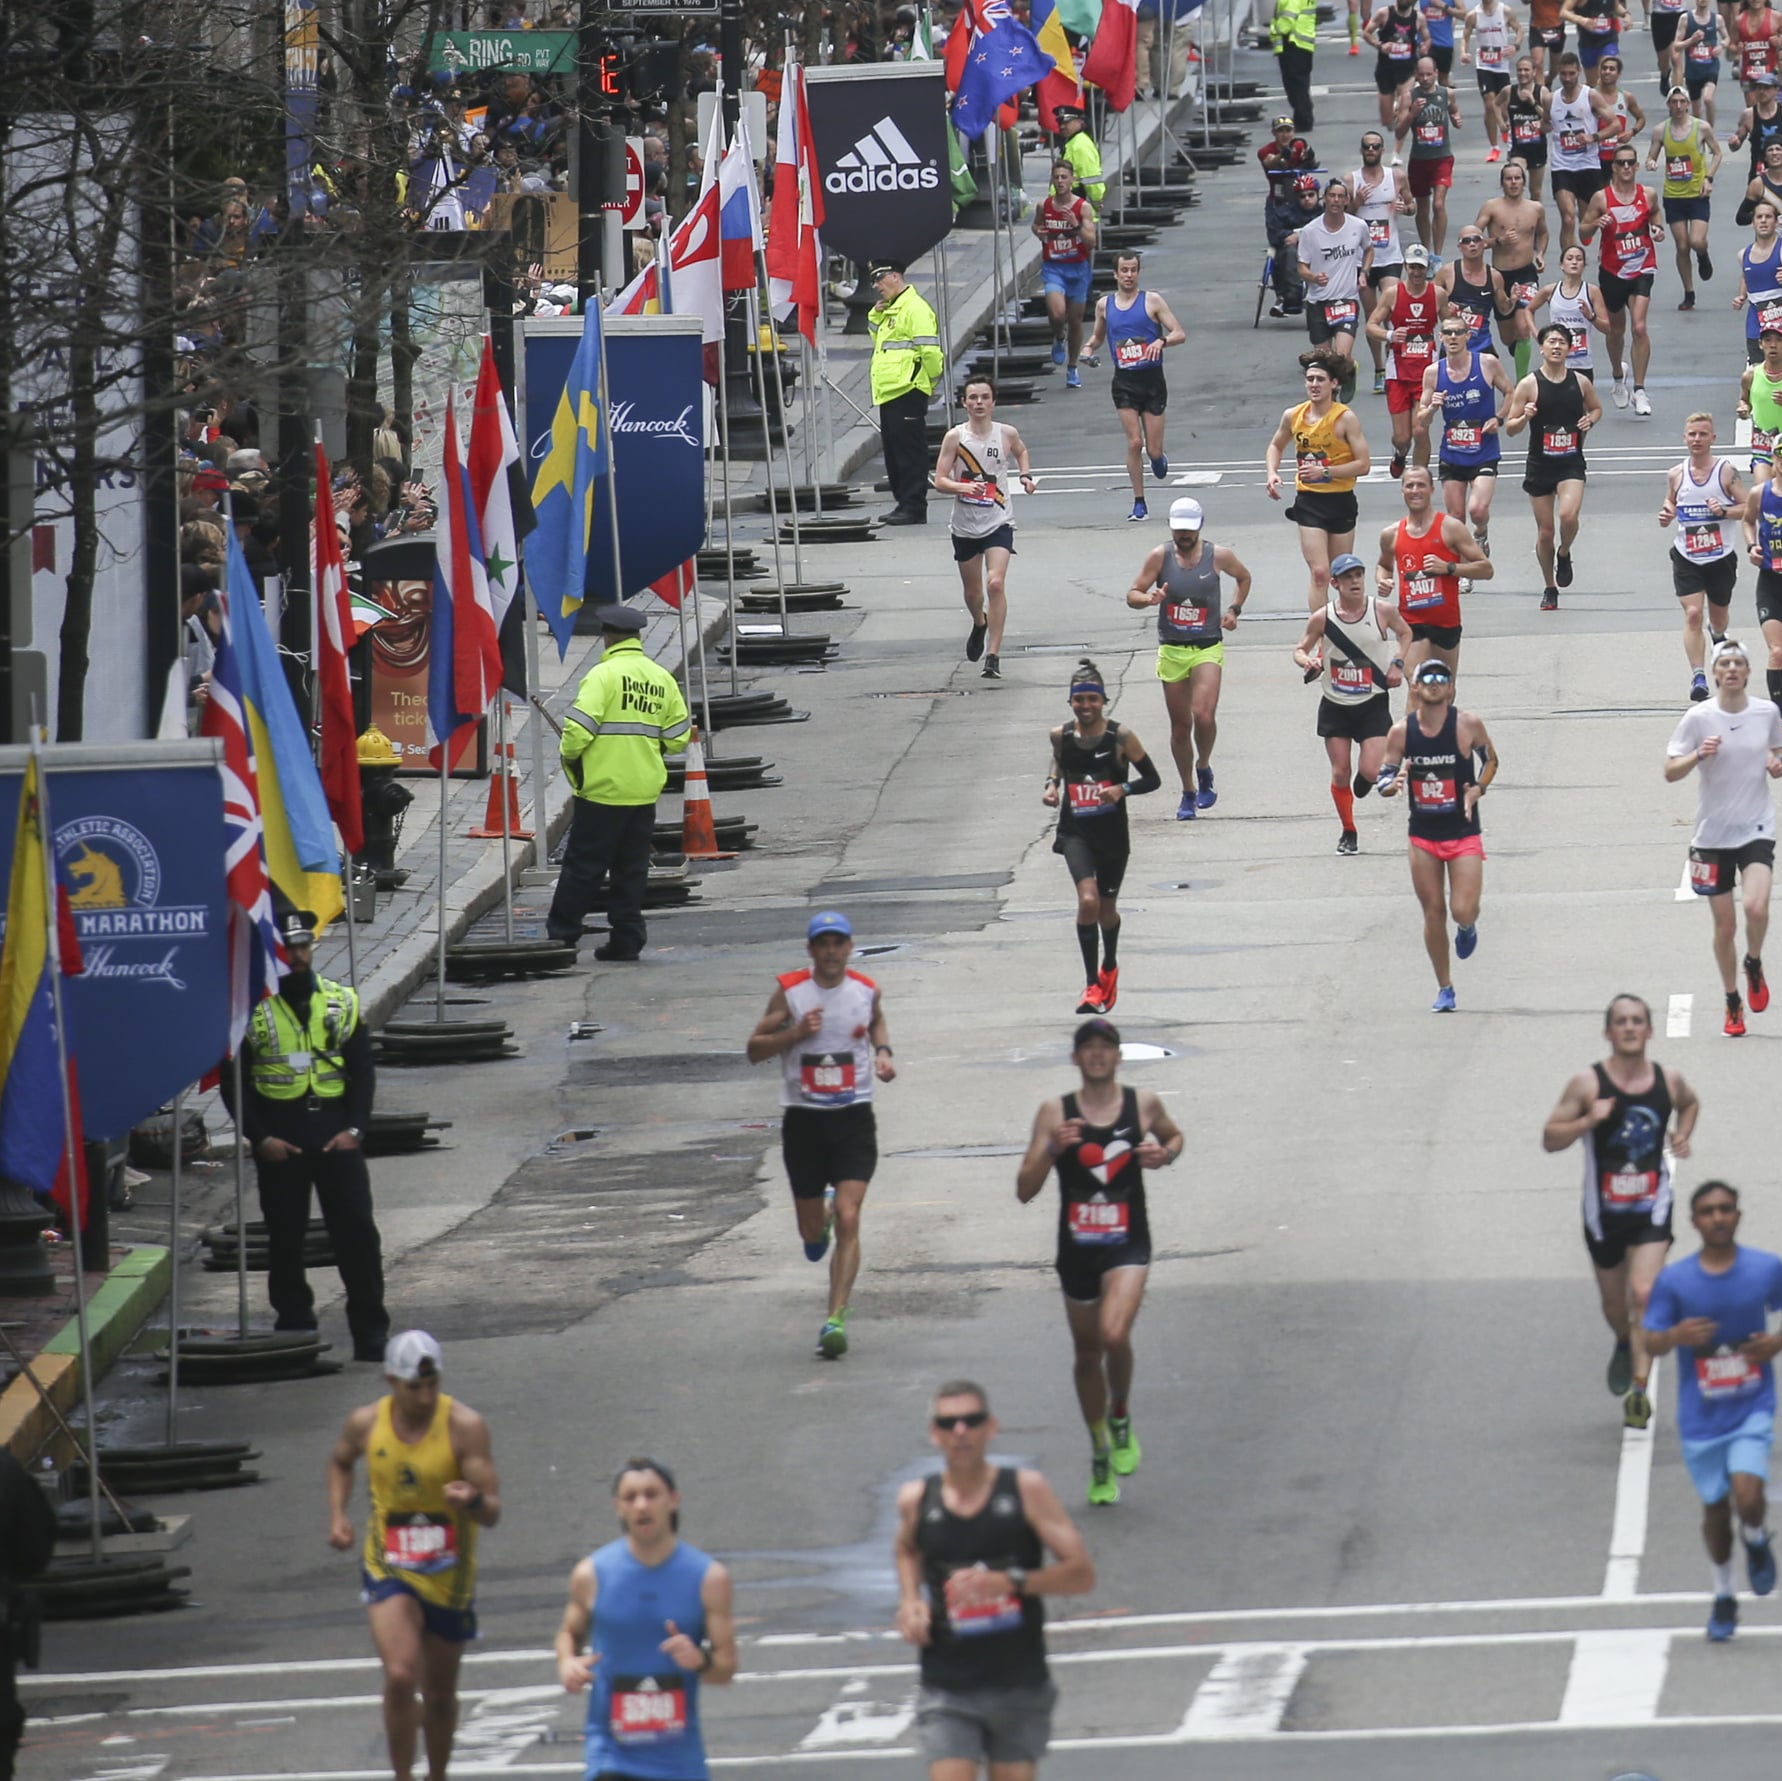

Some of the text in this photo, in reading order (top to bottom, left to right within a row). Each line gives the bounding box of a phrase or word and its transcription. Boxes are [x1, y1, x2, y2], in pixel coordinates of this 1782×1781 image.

[469, 39, 531, 68] RING RD
[535, 49, 550, 58] PVT
[535, 58, 550, 68] WAY
[826, 164, 939, 194] adidas
[609, 400, 702, 447] Hancock
[1454, 427, 1479, 442] 3925
[987, 446, 1000, 460] BQ
[1410, 578, 1437, 594] 3407
[1337, 667, 1364, 682] 2001
[621, 675, 666, 699] Boston
[119, 821, 158, 905] ASSOCIATION
[82, 913, 207, 940] MARATHON
[84, 945, 188, 990] Hancock
